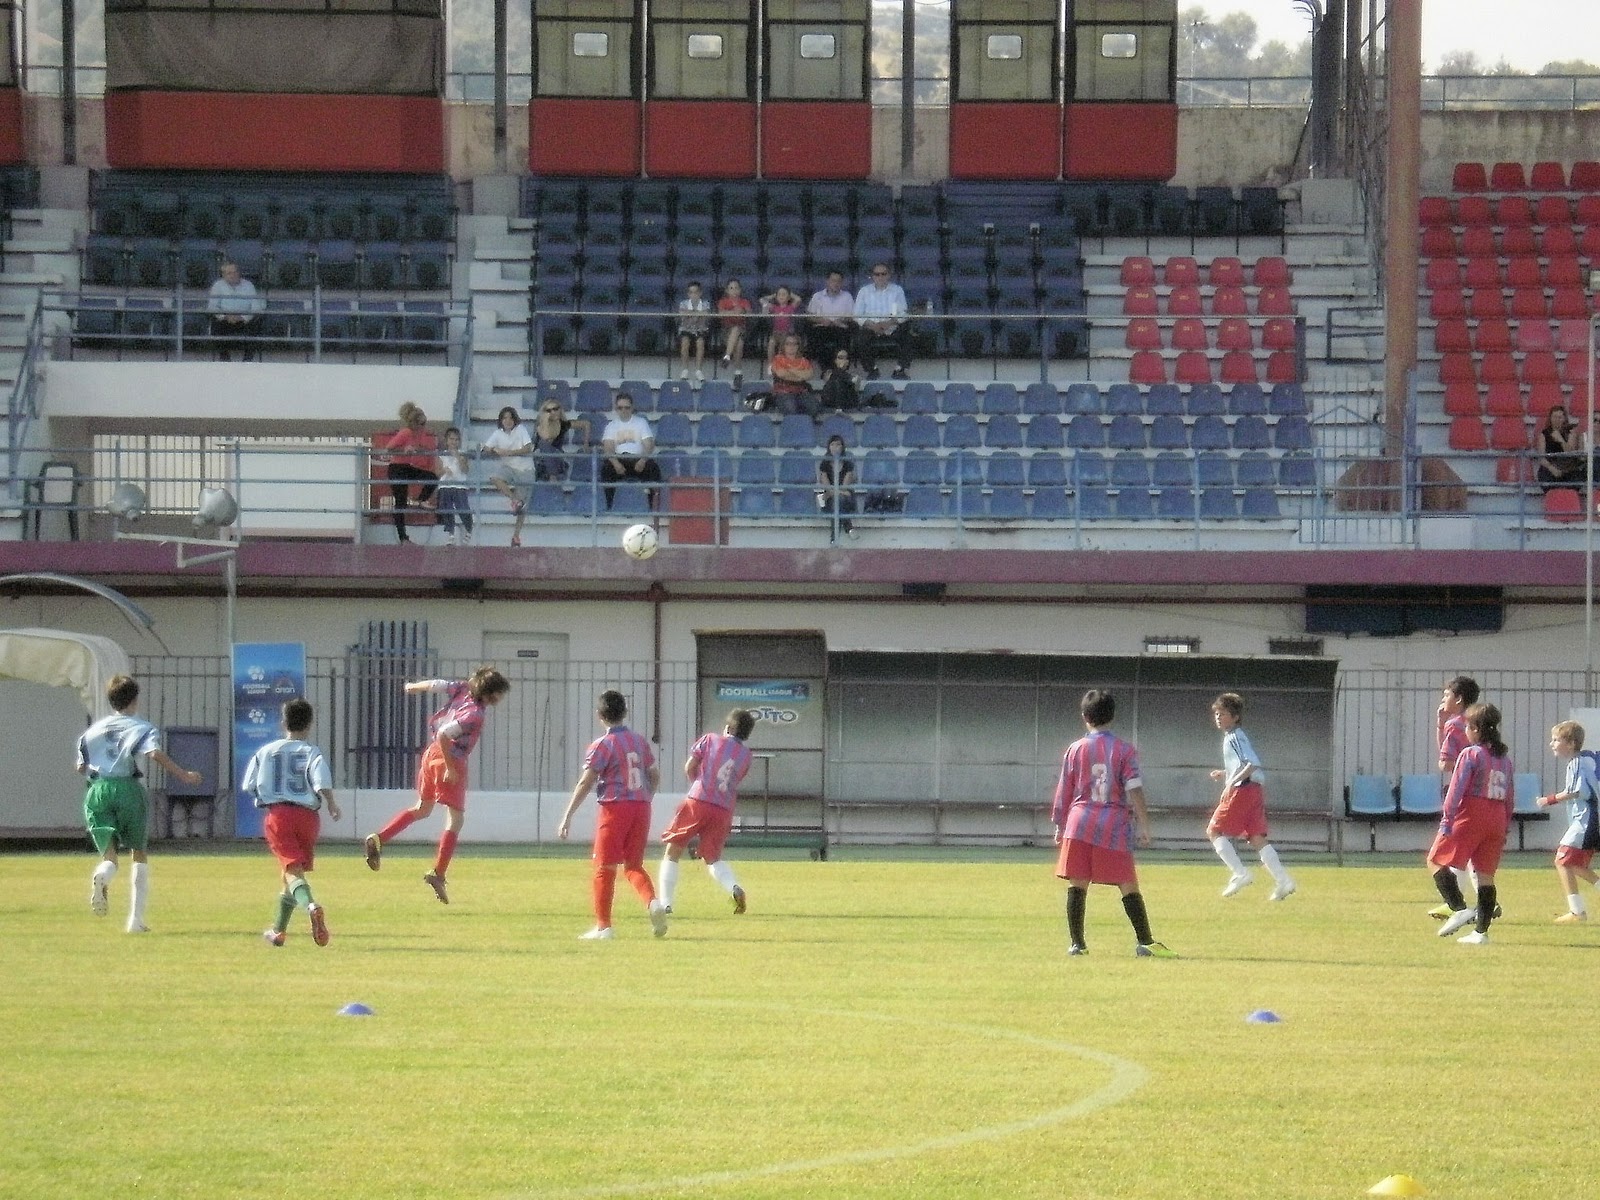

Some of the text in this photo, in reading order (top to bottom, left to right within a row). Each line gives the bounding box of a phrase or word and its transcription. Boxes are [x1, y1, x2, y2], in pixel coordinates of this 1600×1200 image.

[720, 687, 768, 696] FOOTBALL
[268, 752, 308, 795] 15
[626, 751, 643, 791] 6
[1091, 763, 1107, 803] 3
